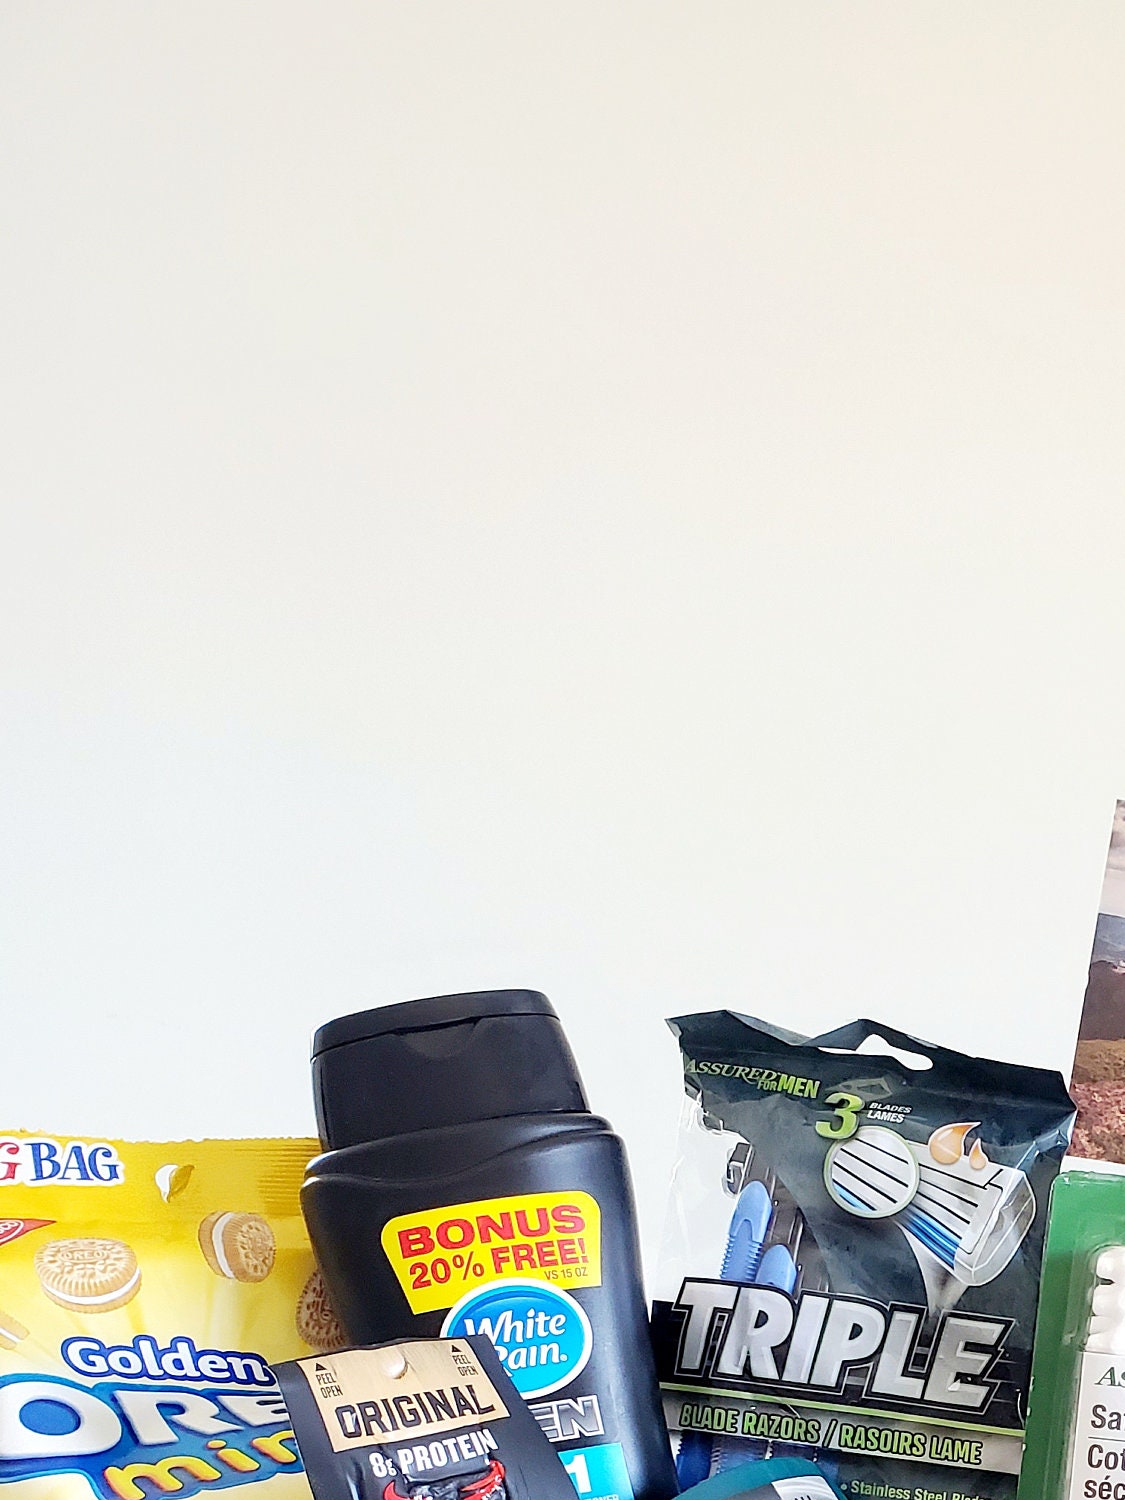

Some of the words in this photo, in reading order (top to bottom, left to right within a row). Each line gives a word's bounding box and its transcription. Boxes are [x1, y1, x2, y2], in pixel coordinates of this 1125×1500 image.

[685, 1058, 778, 1084] ASSURED
[757, 1079, 777, 1092] FOR
[777, 1075, 821, 1099] MEN
[815, 1092, 865, 1139] 3
[867, 1110, 906, 1124] LAMES
[868, 1101, 912, 1114] BLADES
[29, 1142, 120, 1181] BAG
[397, 1204, 586, 1259] BONUS
[409, 1253, 485, 1290] 20%
[491, 1238, 590, 1274] FREE!
[543, 1269, 560, 1281] VS
[561, 1268, 573, 1279] 15
[574, 1267, 589, 1278] OZ
[464, 1307, 567, 1345] White
[674, 1279, 1010, 1411] TRIPLE
[66, 1338, 270, 1381] Golden
[316, 1372, 337, 1386] PEEL
[320, 1384, 344, 1399] OPEN
[335, 1384, 497, 1438] ORIGINAL
[0, 1380, 290, 1460] ORE
[680, 1405, 737, 1433] BLADE
[742, 1412, 822, 1443] RAZORS
[840, 1424, 927, 1458] RASOIRS
[930, 1437, 984, 1465] LAME
[368, 1451, 398, 1478] 8g
[399, 1428, 499, 1474] PROTEIN
[851, 1480, 911, 1500] Stainless
